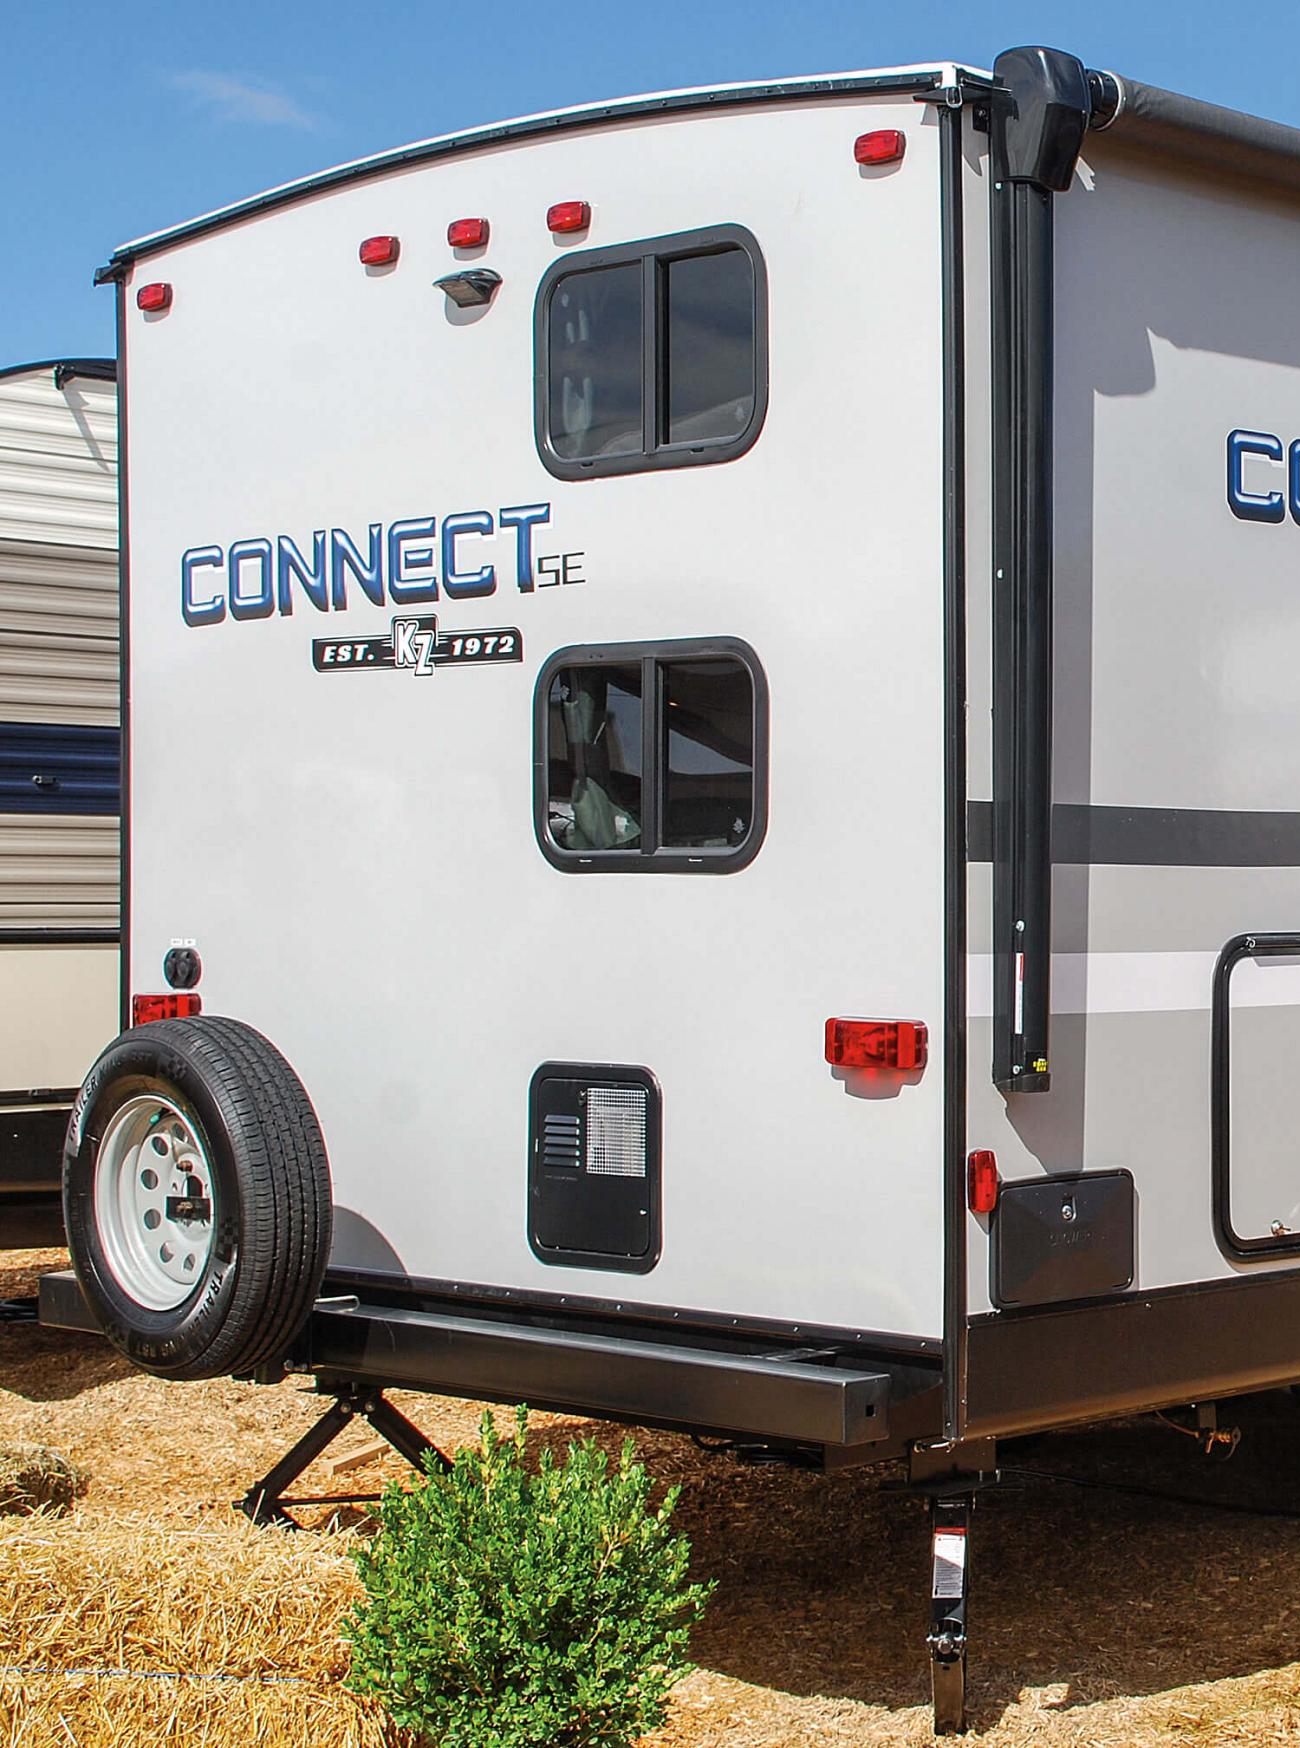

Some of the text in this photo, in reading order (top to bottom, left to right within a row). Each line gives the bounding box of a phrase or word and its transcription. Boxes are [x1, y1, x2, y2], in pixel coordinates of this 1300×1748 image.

[181, 502, 586, 628] CONNECT SE
[322, 621, 514, 676] EST. KZ 1972
